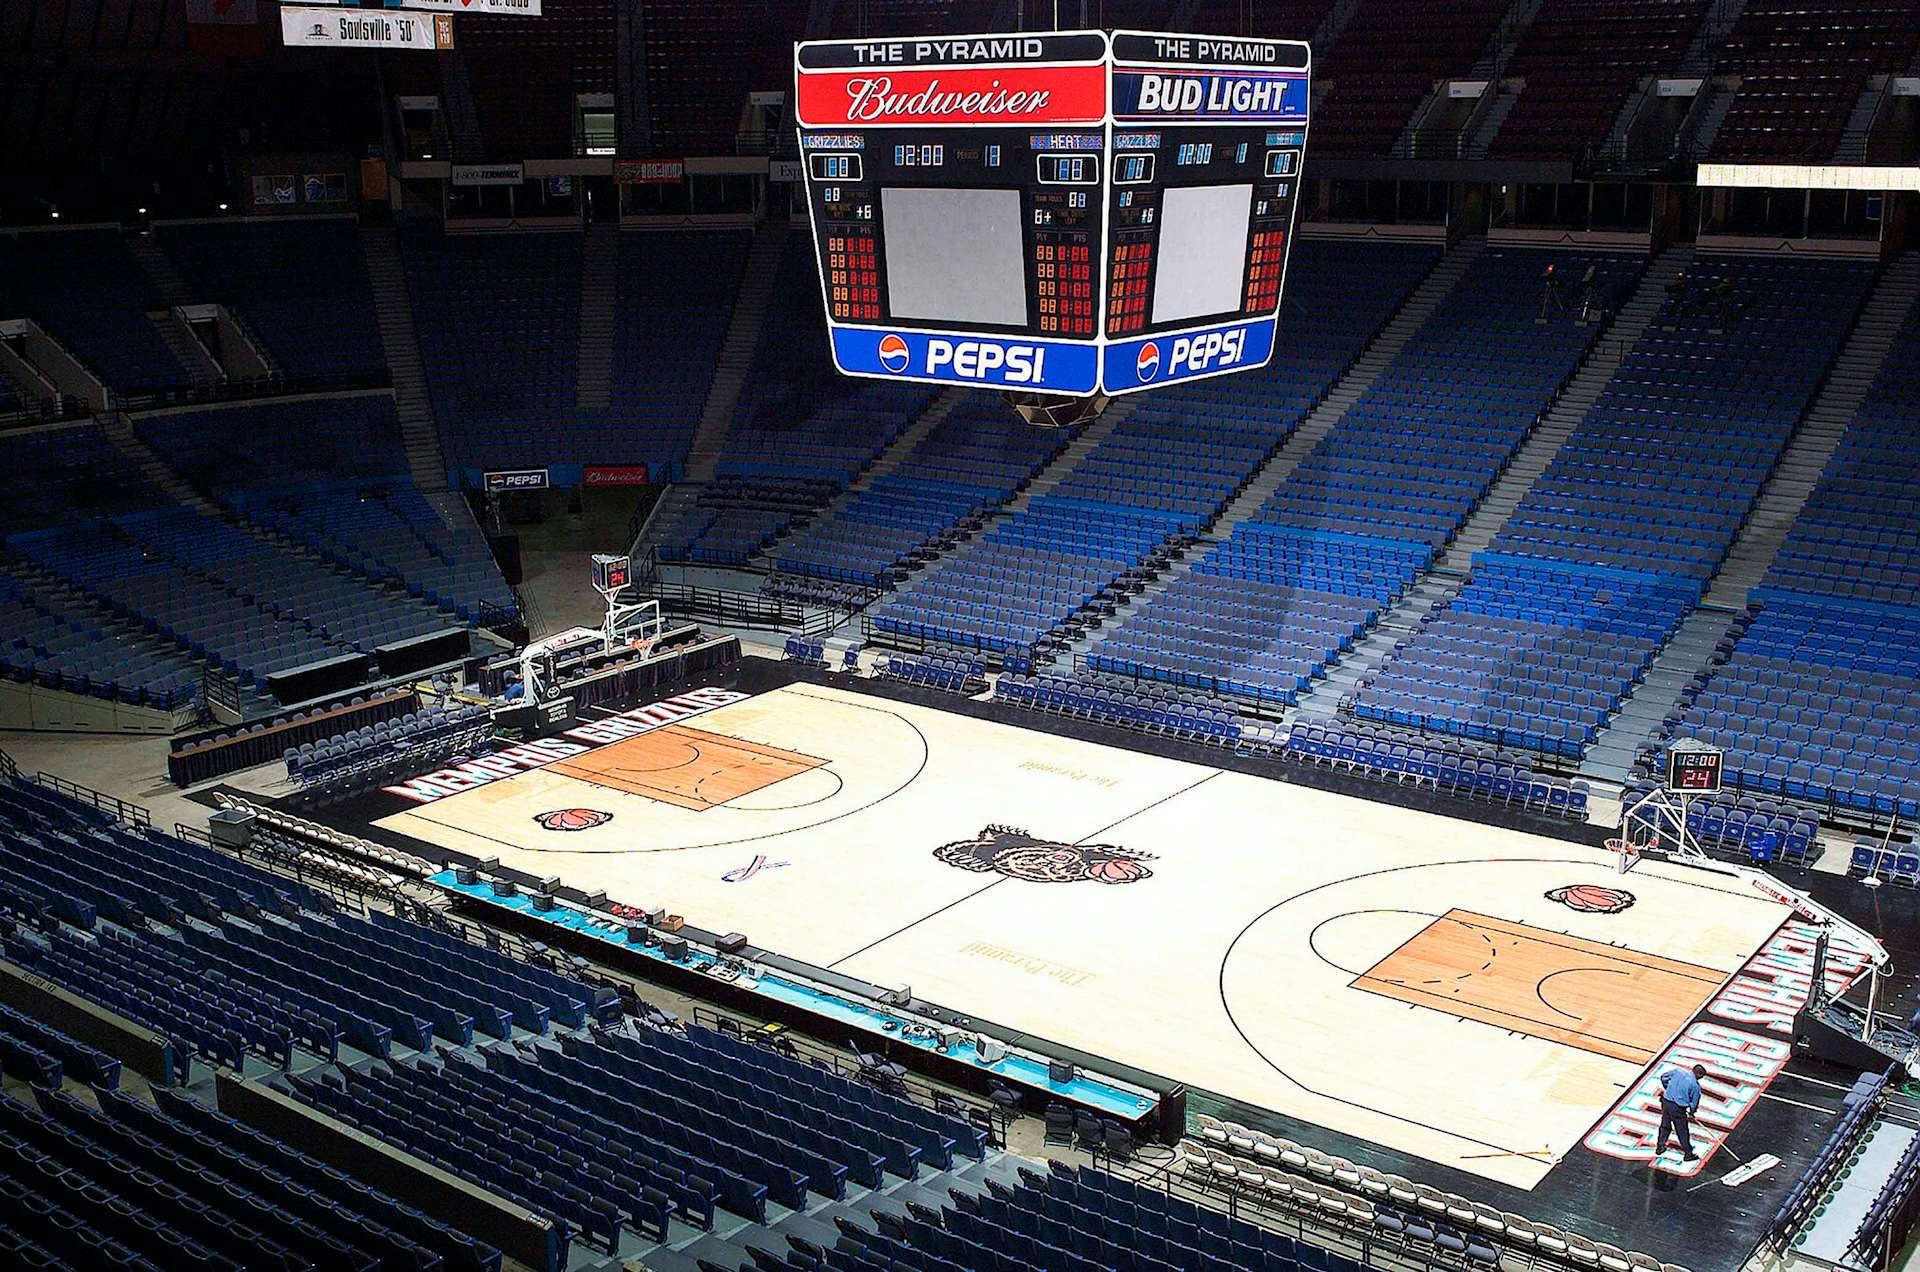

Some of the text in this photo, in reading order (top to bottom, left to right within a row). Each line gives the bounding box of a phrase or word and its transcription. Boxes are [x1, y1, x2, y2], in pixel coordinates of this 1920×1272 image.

[340, 18, 391, 41] Soulsville
[853, 39, 1043, 63] THE PYRAMID
[1154, 39, 1276, 62] THE PYRAMID
[847, 76, 1050, 121] Budweiser
[1138, 74, 1287, 112] BUD LIGHT
[808, 135, 861, 149] GRIZZLIES
[1049, 135, 1081, 149] HEAT
[926, 340, 1044, 384] PEPSI
[1168, 329, 1246, 376] PEPSI
[506, 474, 542, 486] PEPSI
[586, 469, 645, 483] Budweiser
[381, 686, 752, 804] MEMPHIS GRIZZLIES
[1681, 755, 1717, 767] 12:00
[1682, 769, 1710, 788] 24
